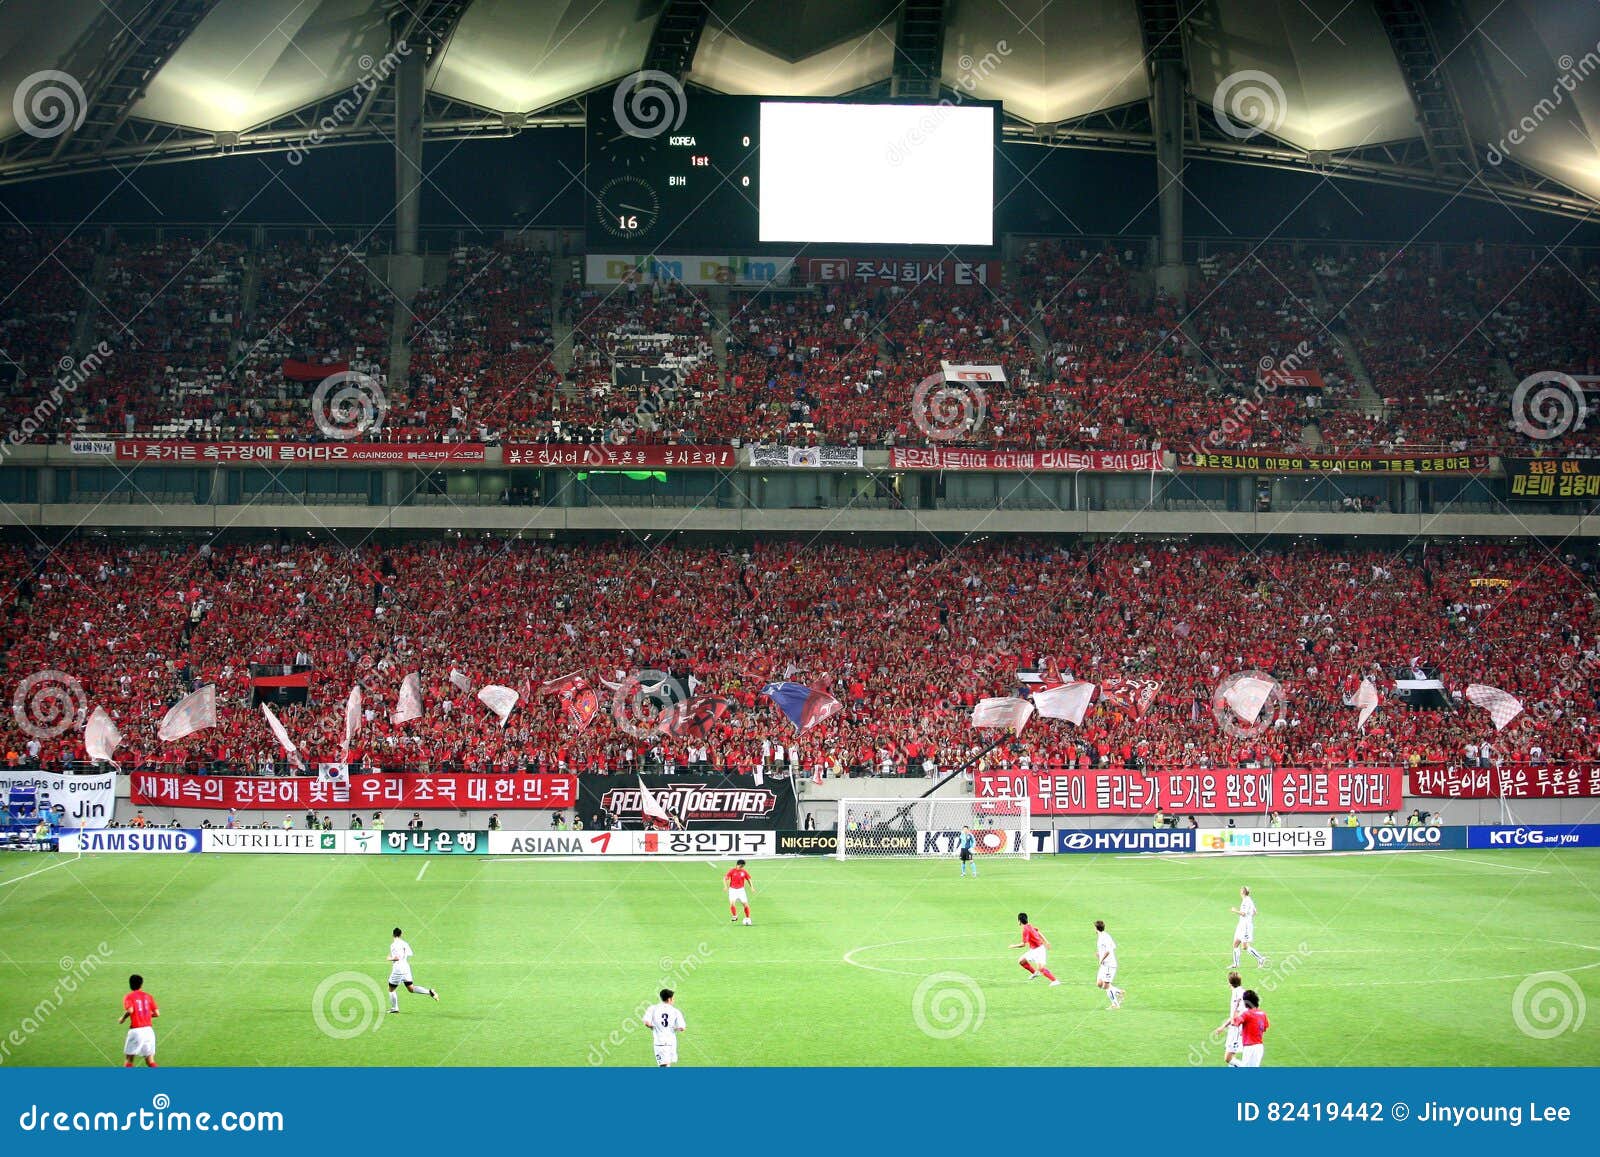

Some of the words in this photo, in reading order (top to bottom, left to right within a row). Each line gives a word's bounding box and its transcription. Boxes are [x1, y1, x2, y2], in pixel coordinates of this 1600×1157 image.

[669, 136, 697, 147] KOREA
[742, 136, 750, 147] 0
[691, 155, 710, 167] 1st
[669, 176, 687, 186] BIH
[742, 176, 750, 186] 0
[619, 215, 638, 230] 16
[820, 263, 845, 280] E1
[855, 261, 945, 284] 주식회사
[955, 263, 987, 285] E1
[122, 444, 139, 459] 나
[145, 444, 197, 460] 죽거든
[203, 444, 272, 460] 축구장에
[352, 451, 404, 460] AGAIN2002
[607, 450, 647, 465] 투혼을
[663, 450, 729, 466] 불사르라!
[1562, 461, 1580, 474] GK
[1560, 474, 1600, 497] 김용대
[0, 778, 49, 789] miracles
[53, 779, 64, 790] of
[69, 779, 112, 793] ground
[137, 775, 224, 801] 세계속의
[234, 779, 298, 803] 찬란히
[361, 778, 403, 801] 우리
[414, 778, 457, 801] 조국
[1535, 768, 1581, 796] 투혼을
[1038, 775, 1086, 809] 부름이
[1096, 774, 1160, 809] 들리는가
[1169, 774, 1217, 808] 뜨거운
[1225, 773, 1273, 808] 환호에
[1282, 772, 1329, 808] 승리로
[1338, 773, 1391, 807] 답하라!
[73, 800, 105, 818] Jin
[79, 832, 188, 851] SAMSUNG
[212, 833, 315, 848] NUTRILITE
[387, 831, 477, 852] 하나은행
[669, 832, 767, 853] 장인가구
[781, 837, 911, 849] NIKEFOOBALL.COM
[1095, 833, 1190, 849] HYUNDAI
[1253, 830, 1327, 848] 미디어다음
[1364, 827, 1441, 850] SOVICO
[1490, 828, 1544, 845] KT&G
[1544, 834, 1559, 843] and
[1561, 834, 1580, 845] you
[510, 837, 584, 853] ASIANA
[661, 1012, 669, 1028] 3
